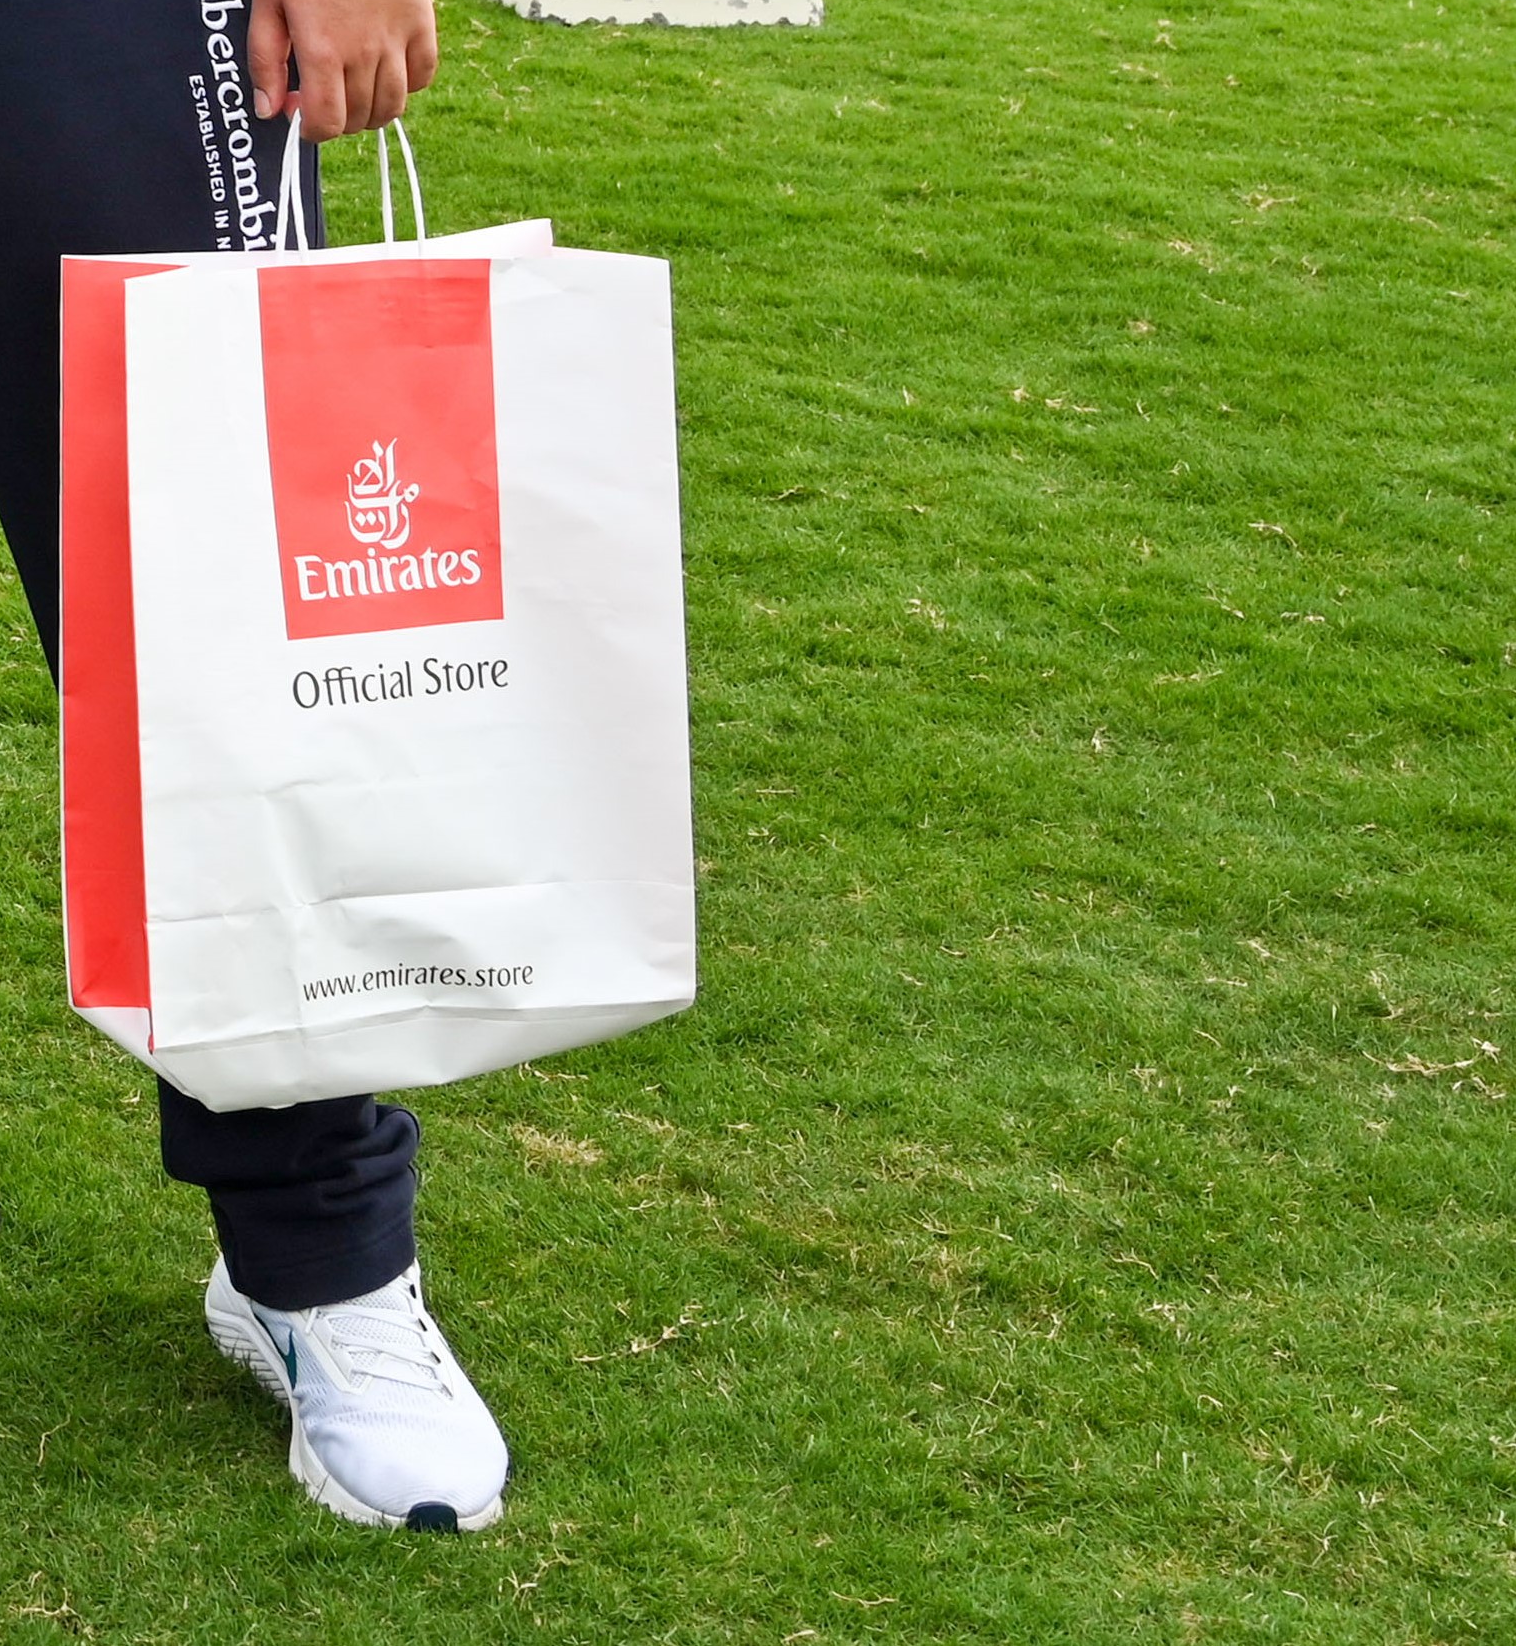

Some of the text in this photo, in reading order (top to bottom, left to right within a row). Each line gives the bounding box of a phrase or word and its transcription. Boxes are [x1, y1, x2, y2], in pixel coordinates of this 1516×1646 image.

[188, 73, 228, 203] ESTABLISHED
[214, 209, 230, 230] IN
[293, 546, 483, 602] Emirates
[292, 657, 510, 709] Official Store
[302, 962, 534, 1002] www.emirates.store
